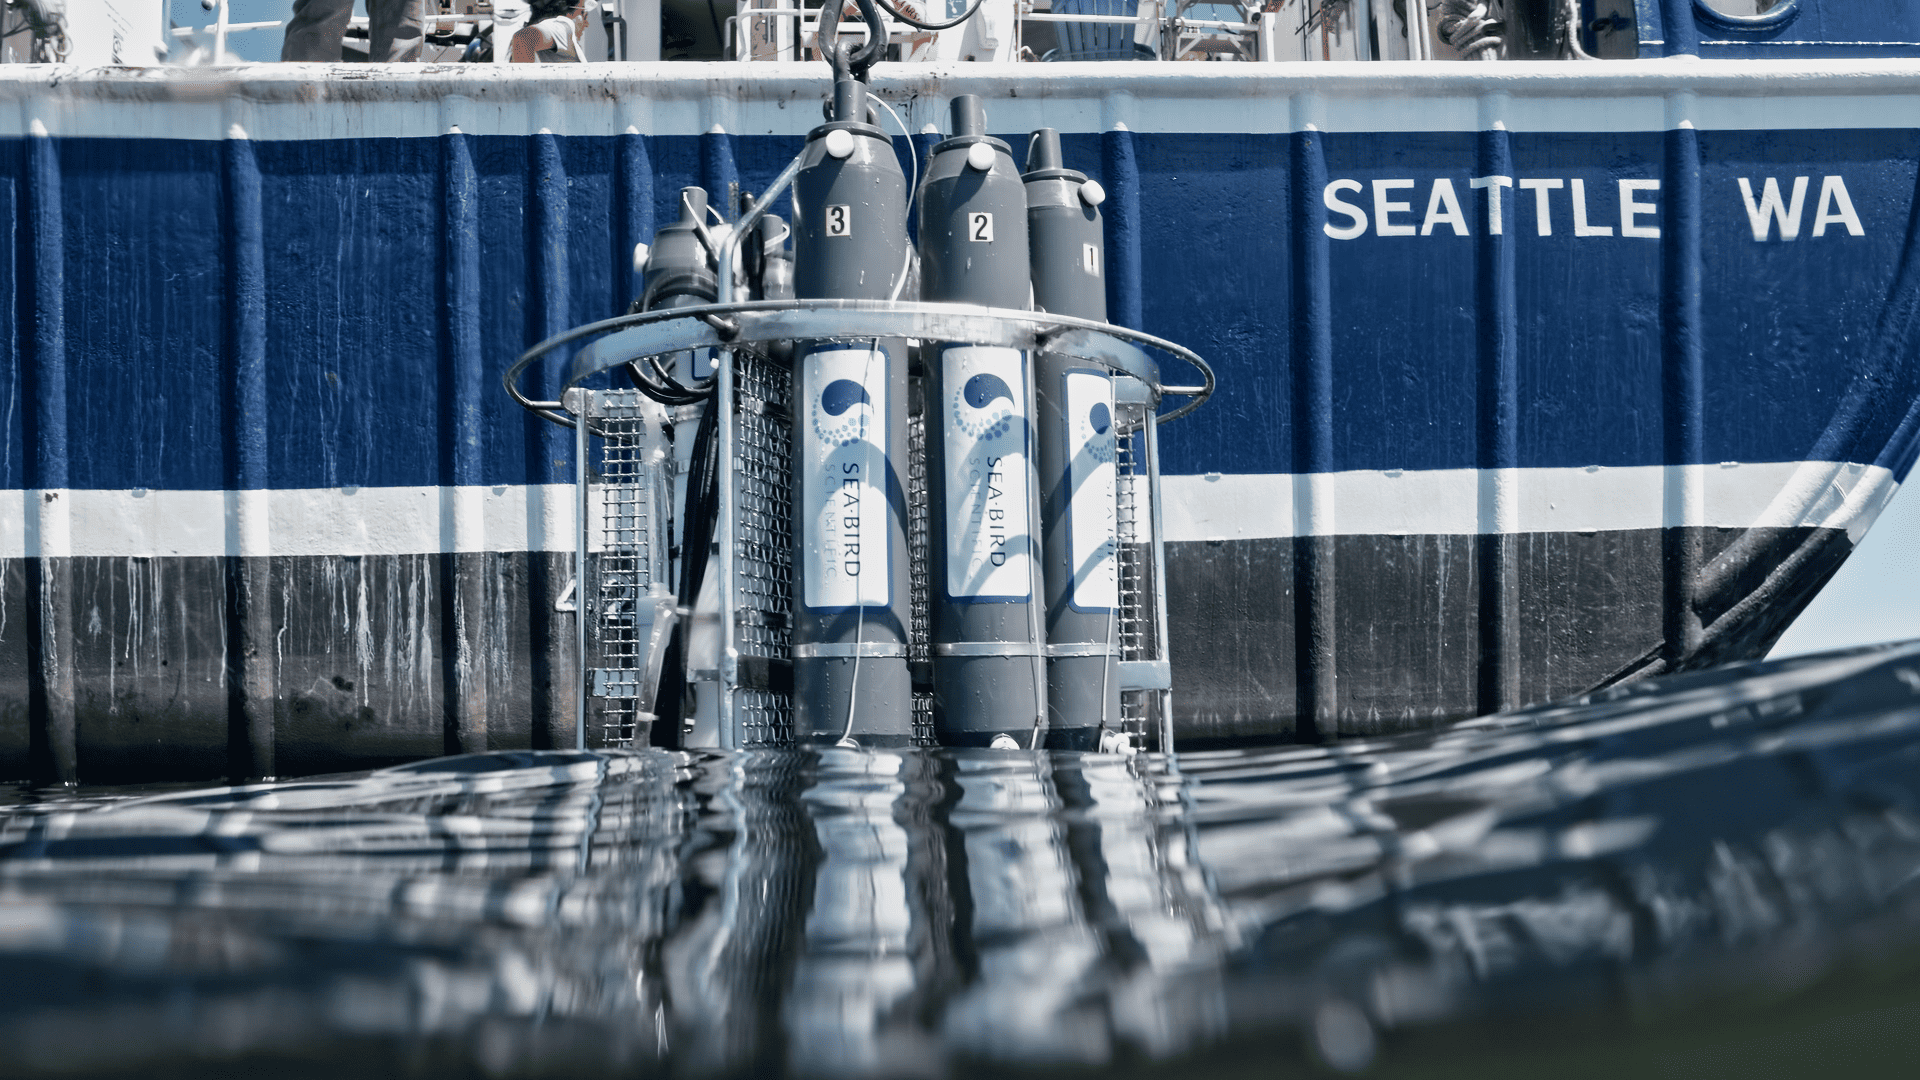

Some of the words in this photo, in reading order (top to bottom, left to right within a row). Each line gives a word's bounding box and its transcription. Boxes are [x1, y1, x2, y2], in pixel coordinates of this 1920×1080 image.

[831, 206, 845, 234] 3
[1323, 176, 1661, 240] SEATTLE
[1737, 175, 1866, 242] WA
[975, 215, 987, 240] 2
